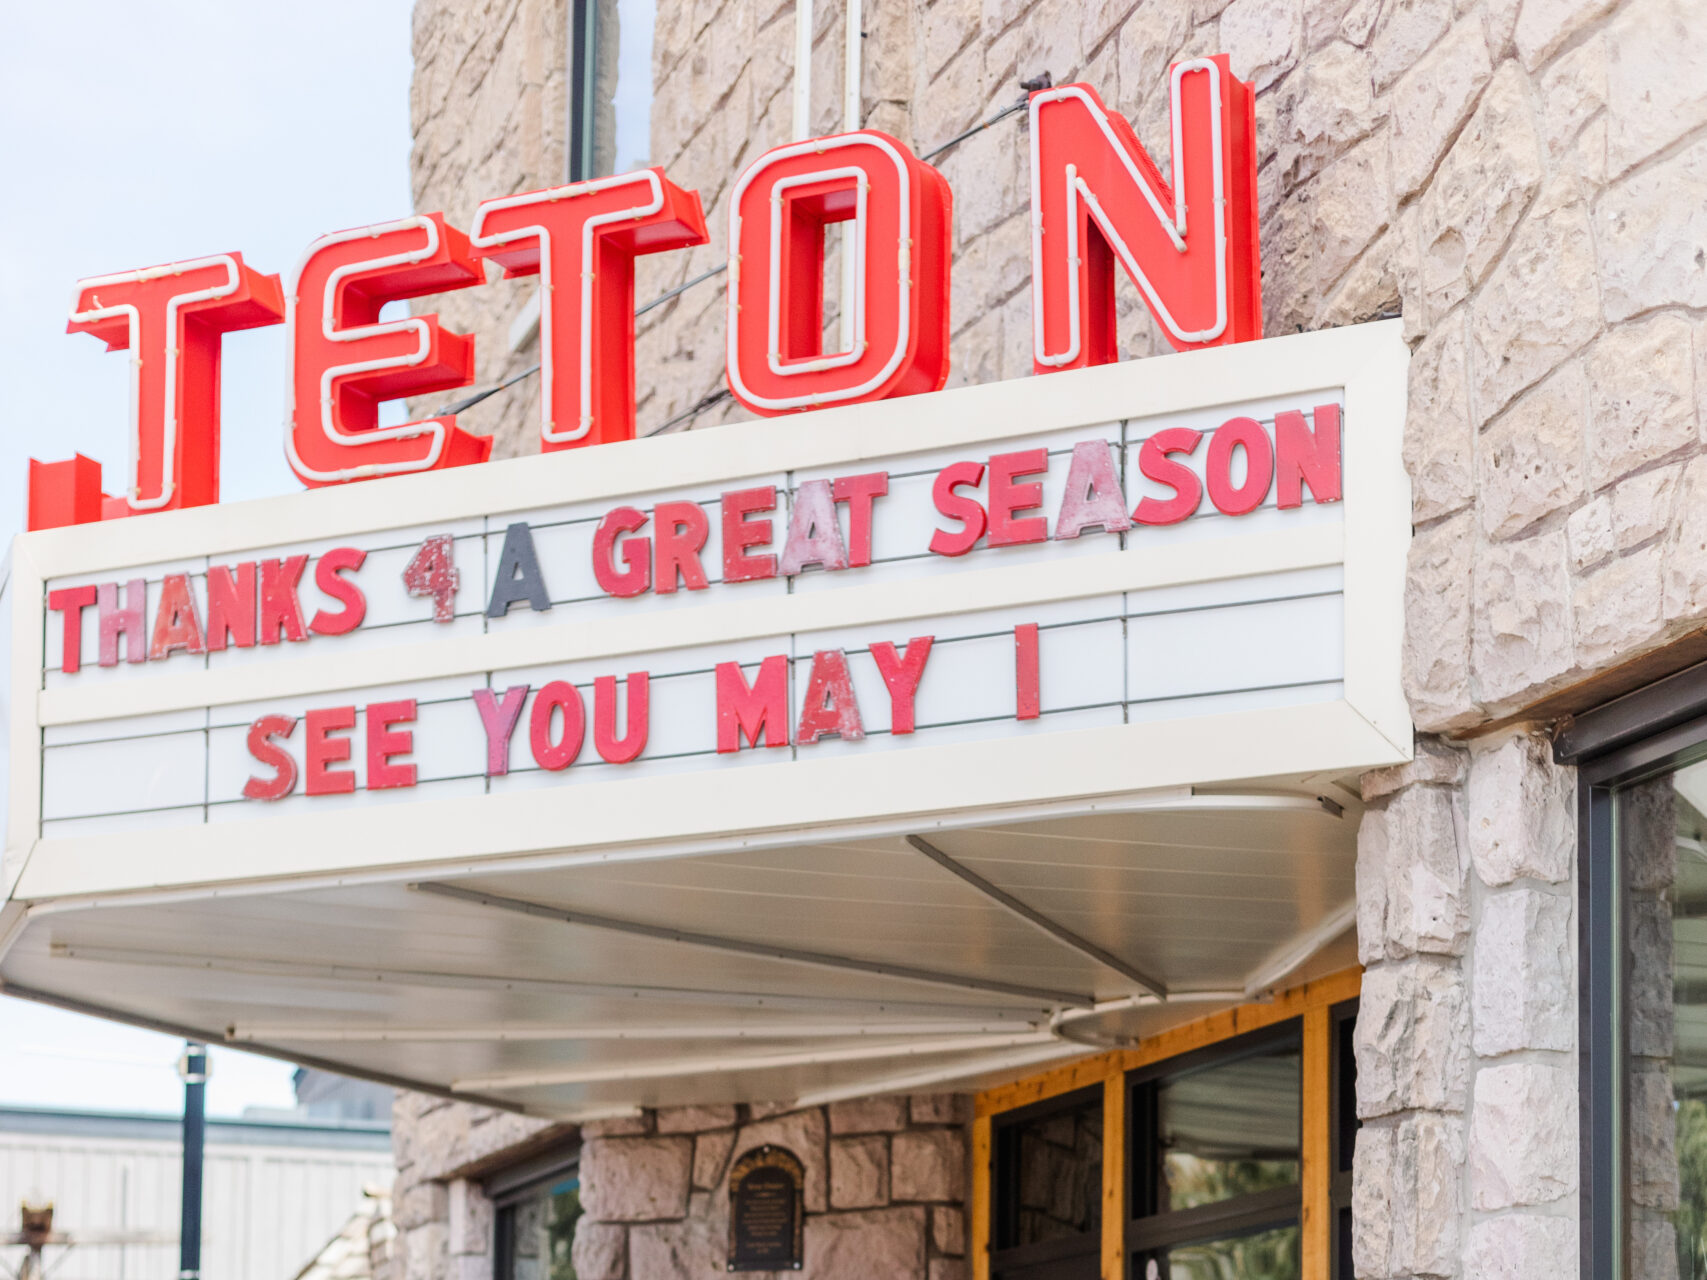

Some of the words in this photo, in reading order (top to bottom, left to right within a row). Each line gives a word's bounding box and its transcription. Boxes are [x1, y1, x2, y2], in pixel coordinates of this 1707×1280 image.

[66, 55, 1262, 513] TETON
[49, 547, 368, 674] THANKS
[401, 533, 460, 624] 4
[487, 522, 551, 619] A
[592, 471, 888, 598] GREAT
[929, 403, 1343, 558] SEASON
[242, 699, 418, 800] SEE
[472, 671, 650, 777] YOU
[715, 635, 935, 754] MAY
